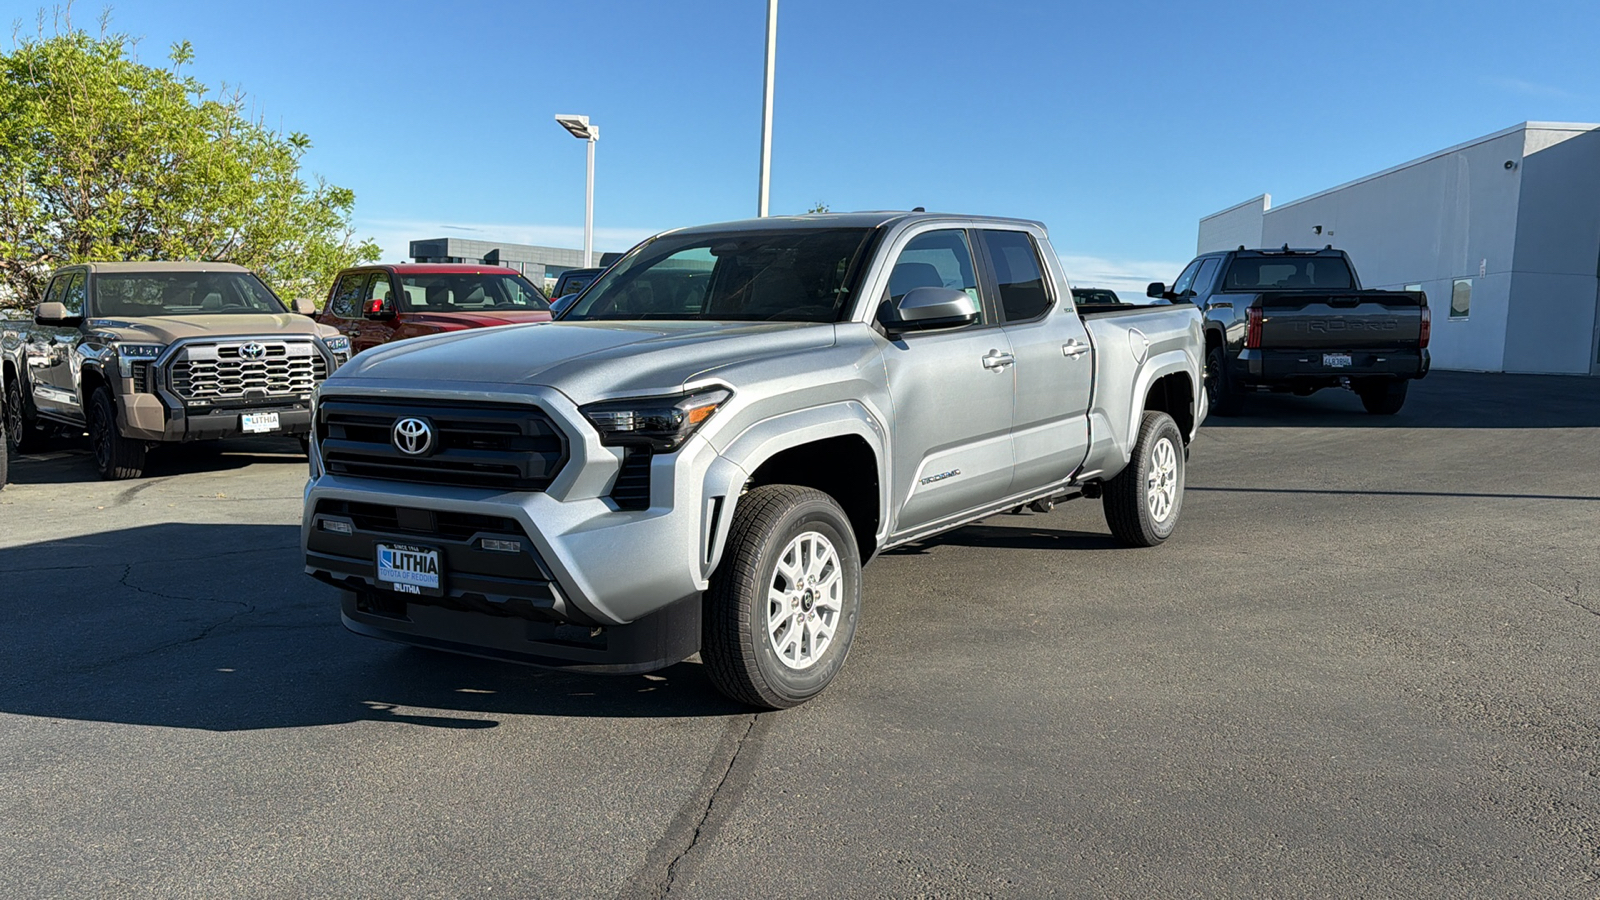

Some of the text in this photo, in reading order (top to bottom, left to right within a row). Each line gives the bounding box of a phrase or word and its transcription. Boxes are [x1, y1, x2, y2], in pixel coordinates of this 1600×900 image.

[251, 415, 278, 424] LITHIA
[393, 551, 438, 574] LITHIA
[380, 568, 438, 583] TOYOTA OF REDDING
[400, 584, 421, 595] LITHIA
